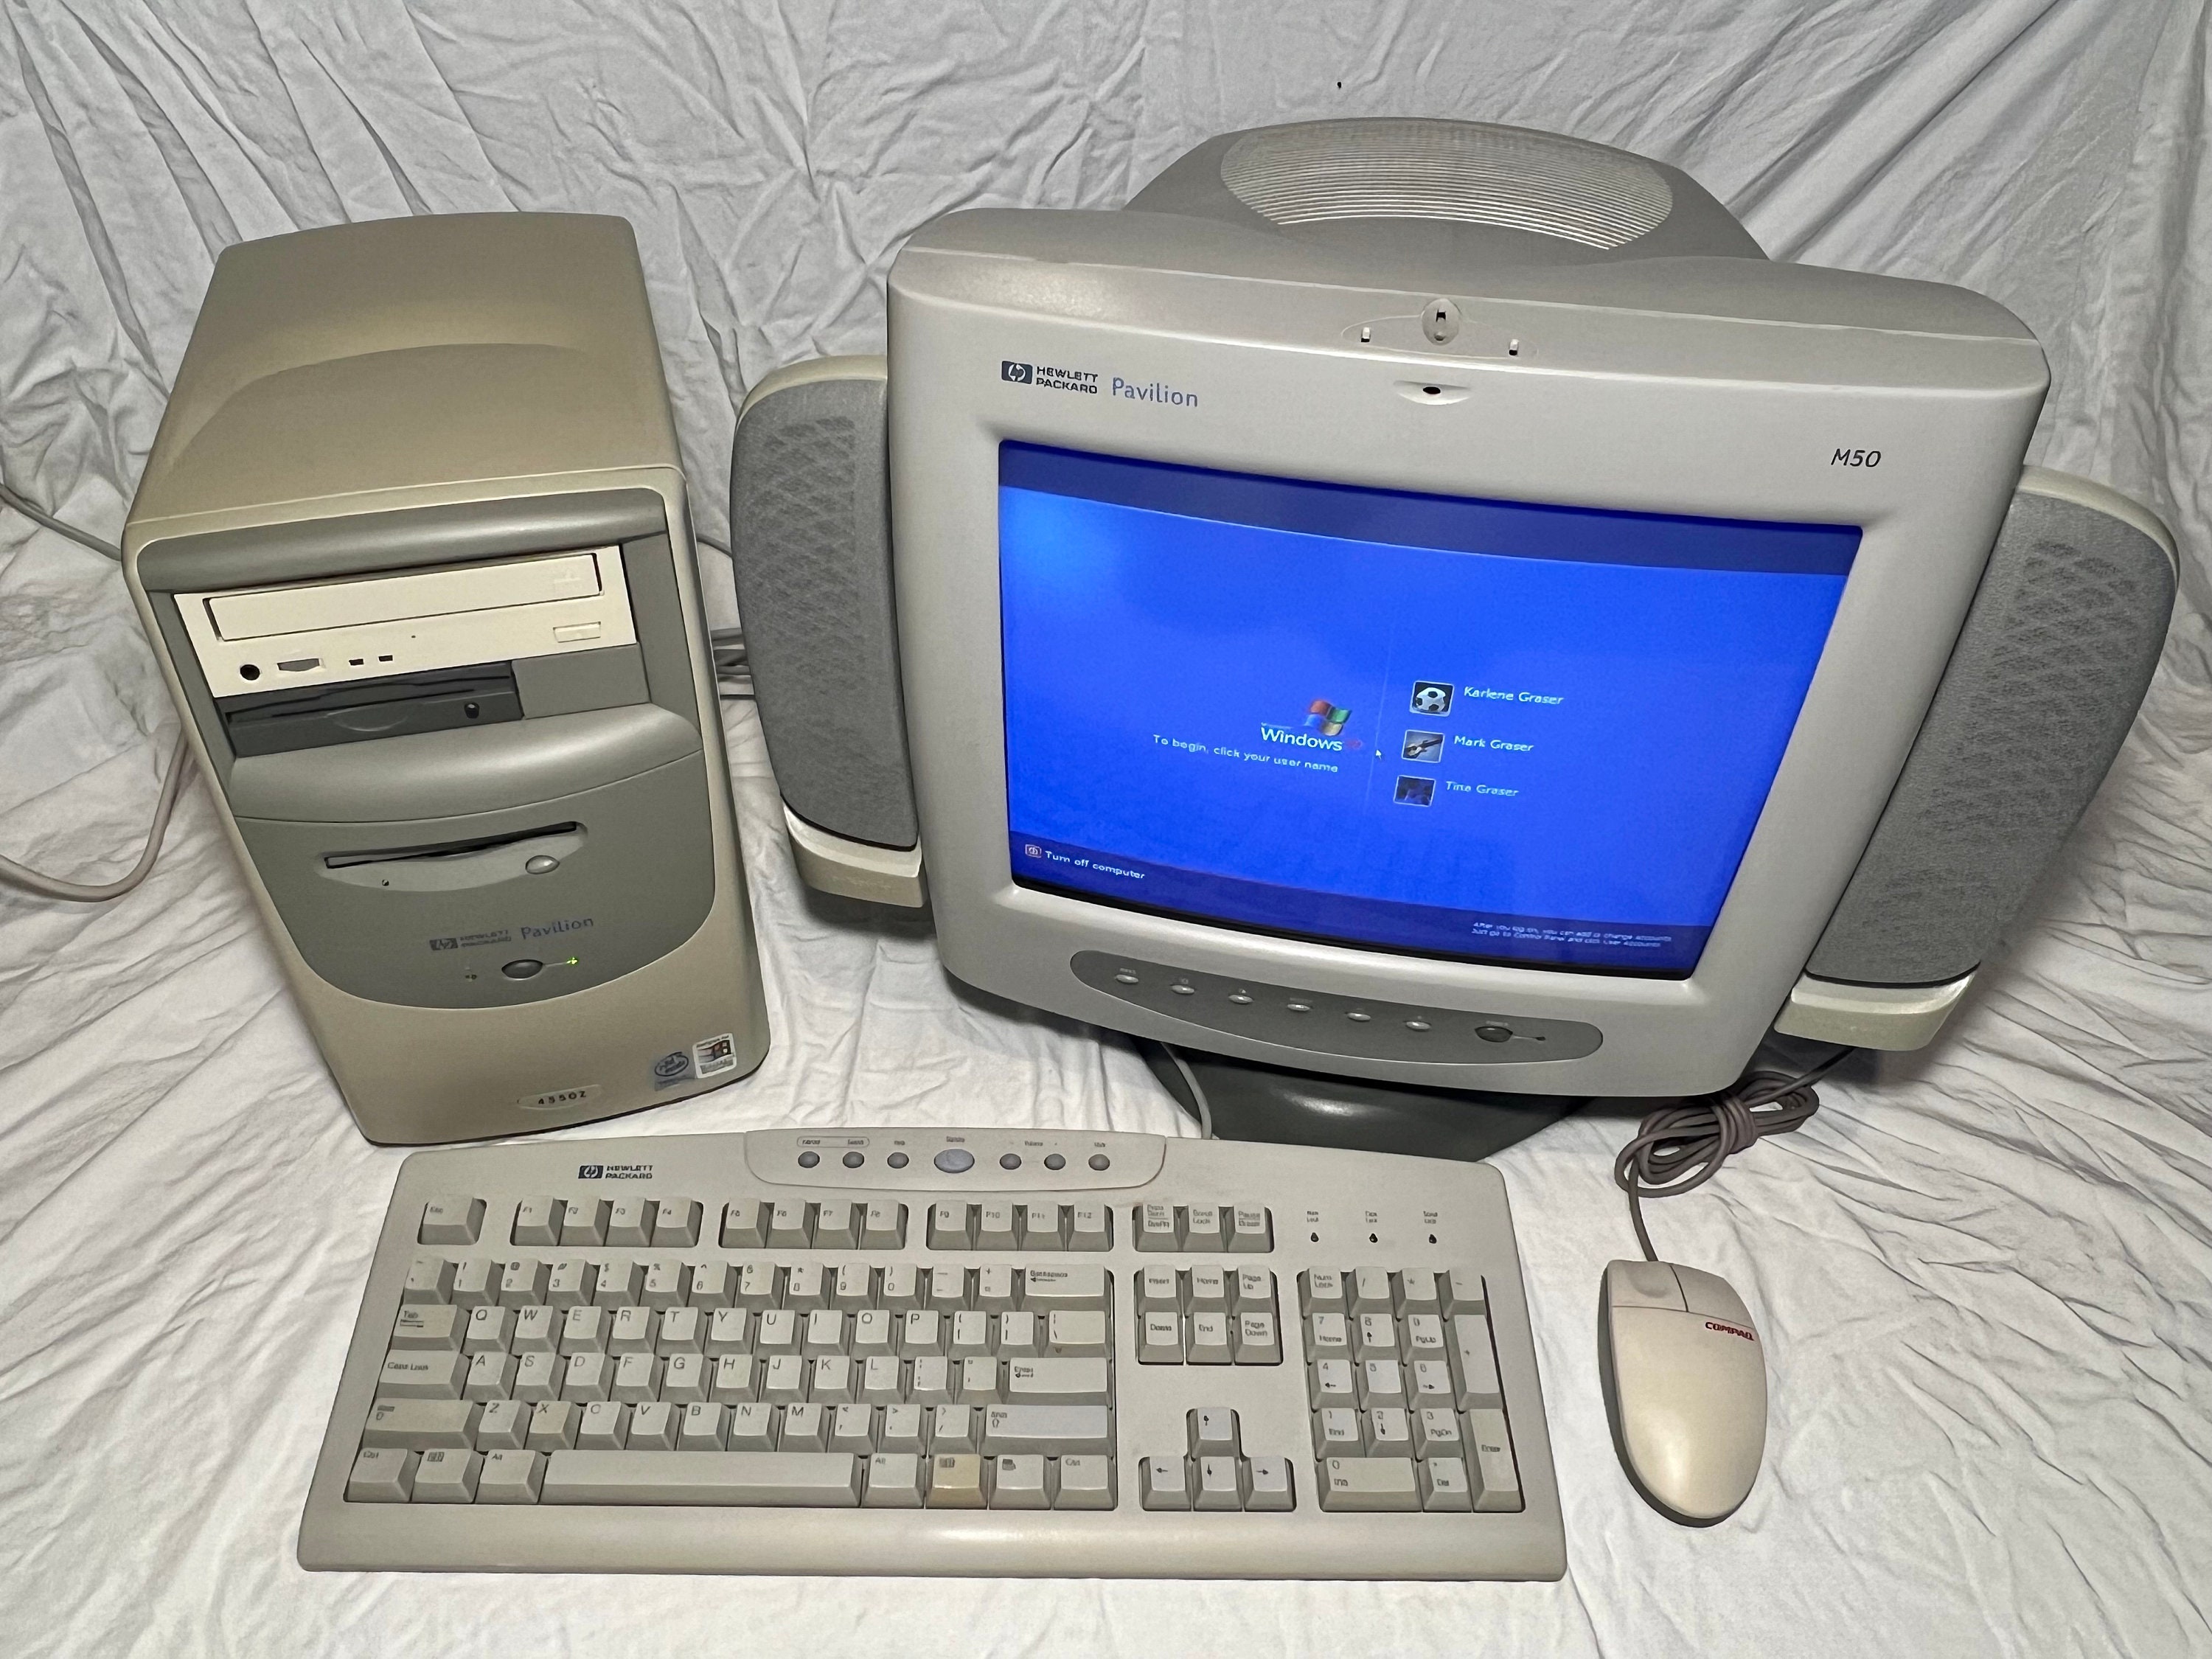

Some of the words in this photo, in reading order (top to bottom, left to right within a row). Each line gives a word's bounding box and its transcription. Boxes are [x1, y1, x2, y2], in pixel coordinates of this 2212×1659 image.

[1037, 366, 1098, 383] HEWLETT
[1036, 378, 1097, 394] PACKARD
[1112, 377, 1198, 407] Pavilion
[1831, 448, 1881, 467] M50
[1464, 686, 1514, 700] Karlene
[1518, 692, 1564, 705] Graser
[1260, 726, 1343, 751] Windows
[1454, 735, 1486, 748] Mark
[1490, 740, 1534, 751] Graser
[1153, 734, 1169, 745] To
[1214, 746, 1240, 758] click
[1244, 751, 1271, 762] your
[1273, 757, 1301, 768] user
[1304, 762, 1338, 773] name
[1446, 781, 1471, 792] Tina
[1476, 785, 1519, 796] Graser
[1045, 850, 1070, 863] Turn
[1074, 858, 1090, 868] off
[1093, 863, 1145, 880] computer
[521, 918, 594, 940] Pavilion
[744, 1281, 751, 1291] 7
[475, 1309, 487, 1321] Q
[524, 1309, 538, 1321] W
[572, 1310, 582, 1321] E
[620, 1310, 632, 1322] R
[670, 1310, 680, 1323] T
[718, 1311, 729, 1323] Y
[766, 1313, 777, 1326] U
[861, 1312, 873, 1324] O
[910, 1313, 920, 1325] P
[476, 1354, 486, 1366] A
[524, 1355, 535, 1367] S
[574, 1356, 585, 1367] D
[623, 1357, 633, 1368] F
[673, 1357, 686, 1369] G
[723, 1358, 735, 1370] H
[773, 1358, 782, 1370] J
[821, 1359, 832, 1370] K
[870, 1359, 878, 1370] L
[489, 1403, 499, 1413] Z
[539, 1403, 550, 1413] X
[591, 1404, 601, 1414] C
[641, 1405, 651, 1415] V
[691, 1405, 701, 1416] B
[741, 1405, 751, 1416] N
[791, 1406, 804, 1417] M
